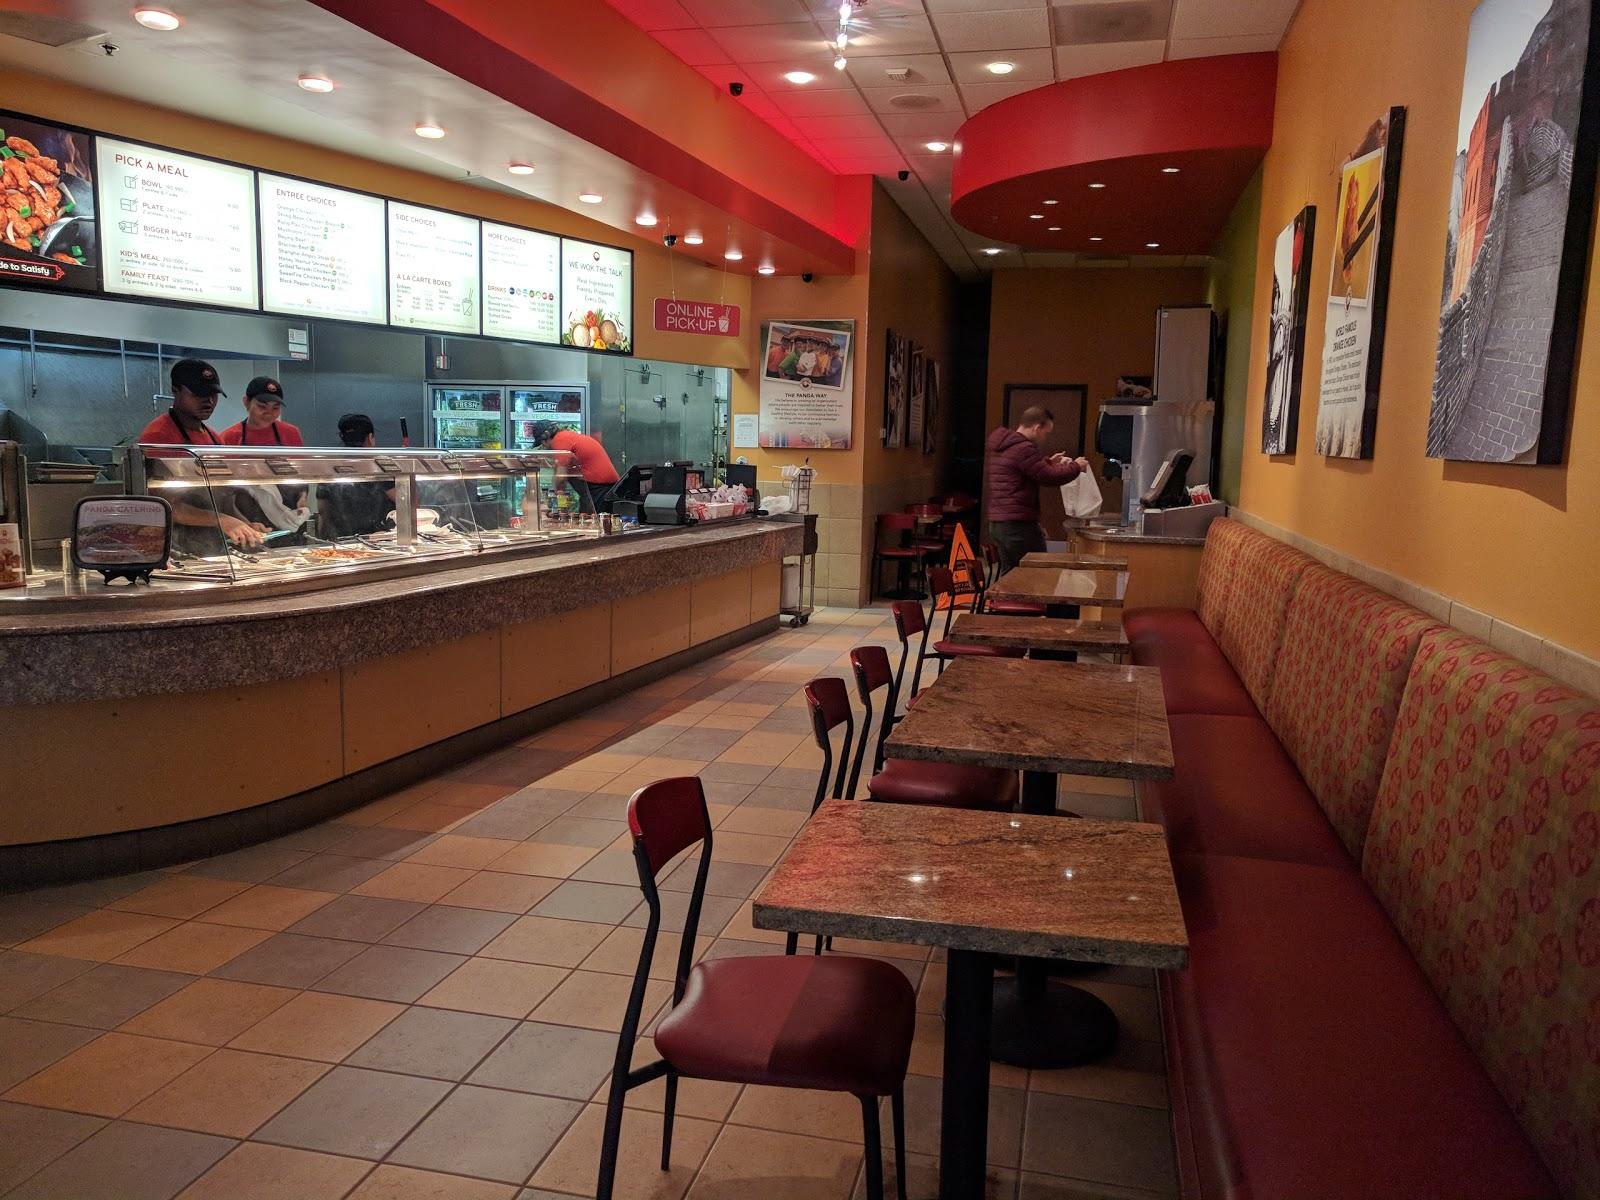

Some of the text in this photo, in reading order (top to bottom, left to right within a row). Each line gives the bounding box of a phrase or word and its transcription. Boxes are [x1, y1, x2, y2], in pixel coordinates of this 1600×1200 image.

[115, 153, 189, 178] PICK A MEAL
[141, 179, 163, 189] BOWL
[276, 188, 337, 207] ENTREE CHOICES
[142, 202, 165, 212] PLATE
[395, 213, 437, 227] SIDE CHOICES
[143, 225, 170, 236] BIGGER
[171, 229, 192, 239] PLATE
[488, 232, 527, 245] MORE CHOICES
[120, 249, 139, 259] KID'S
[140, 252, 161, 262] MEAL
[21, 264, 50, 276] Satisfy
[568, 259, 623, 277] WE WOK THE TALK
[121, 269, 146, 279] FAMILY
[147, 272, 170, 282] FEAST
[411, 275, 432, 285] CARTE
[432, 278, 452, 287] BOXES
[487, 284, 507, 293] DRINKS
[666, 303, 715, 319] ONLINE
